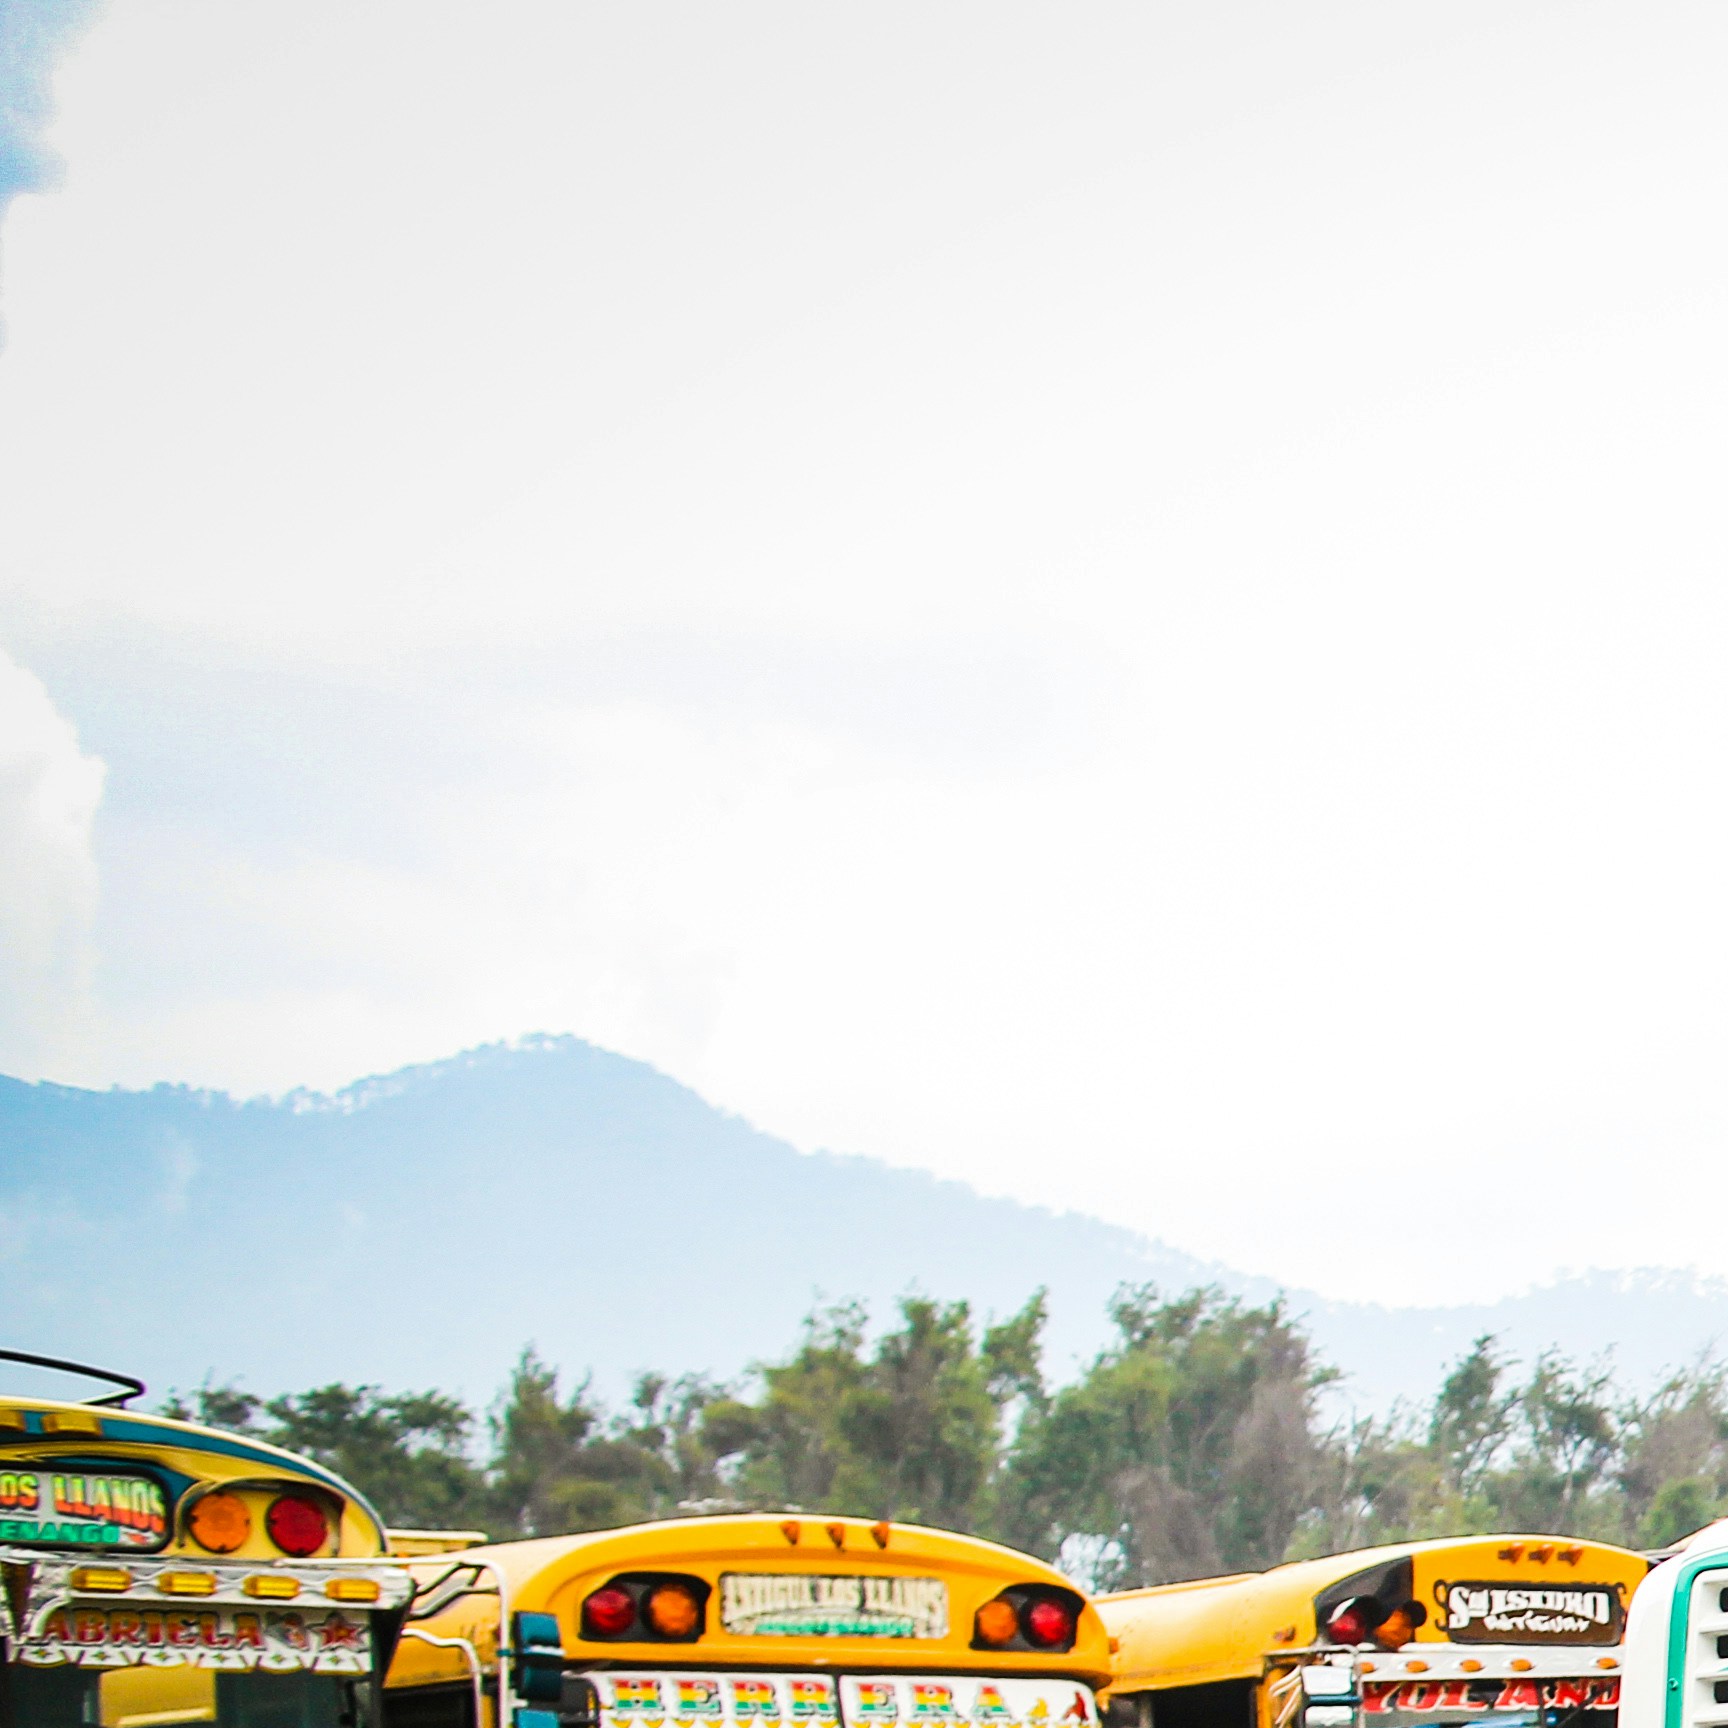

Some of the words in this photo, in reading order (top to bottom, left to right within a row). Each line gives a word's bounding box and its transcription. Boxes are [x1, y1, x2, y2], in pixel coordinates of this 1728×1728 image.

[53, 1475, 166, 1534] LLANOS
[818, 1577, 860, 1608] LOS
[1490, 1589, 1610, 1624] ISIDRO
[34, 1609, 264, 1648] ABRIELA
[608, 1678, 1014, 1722] HERRERA
